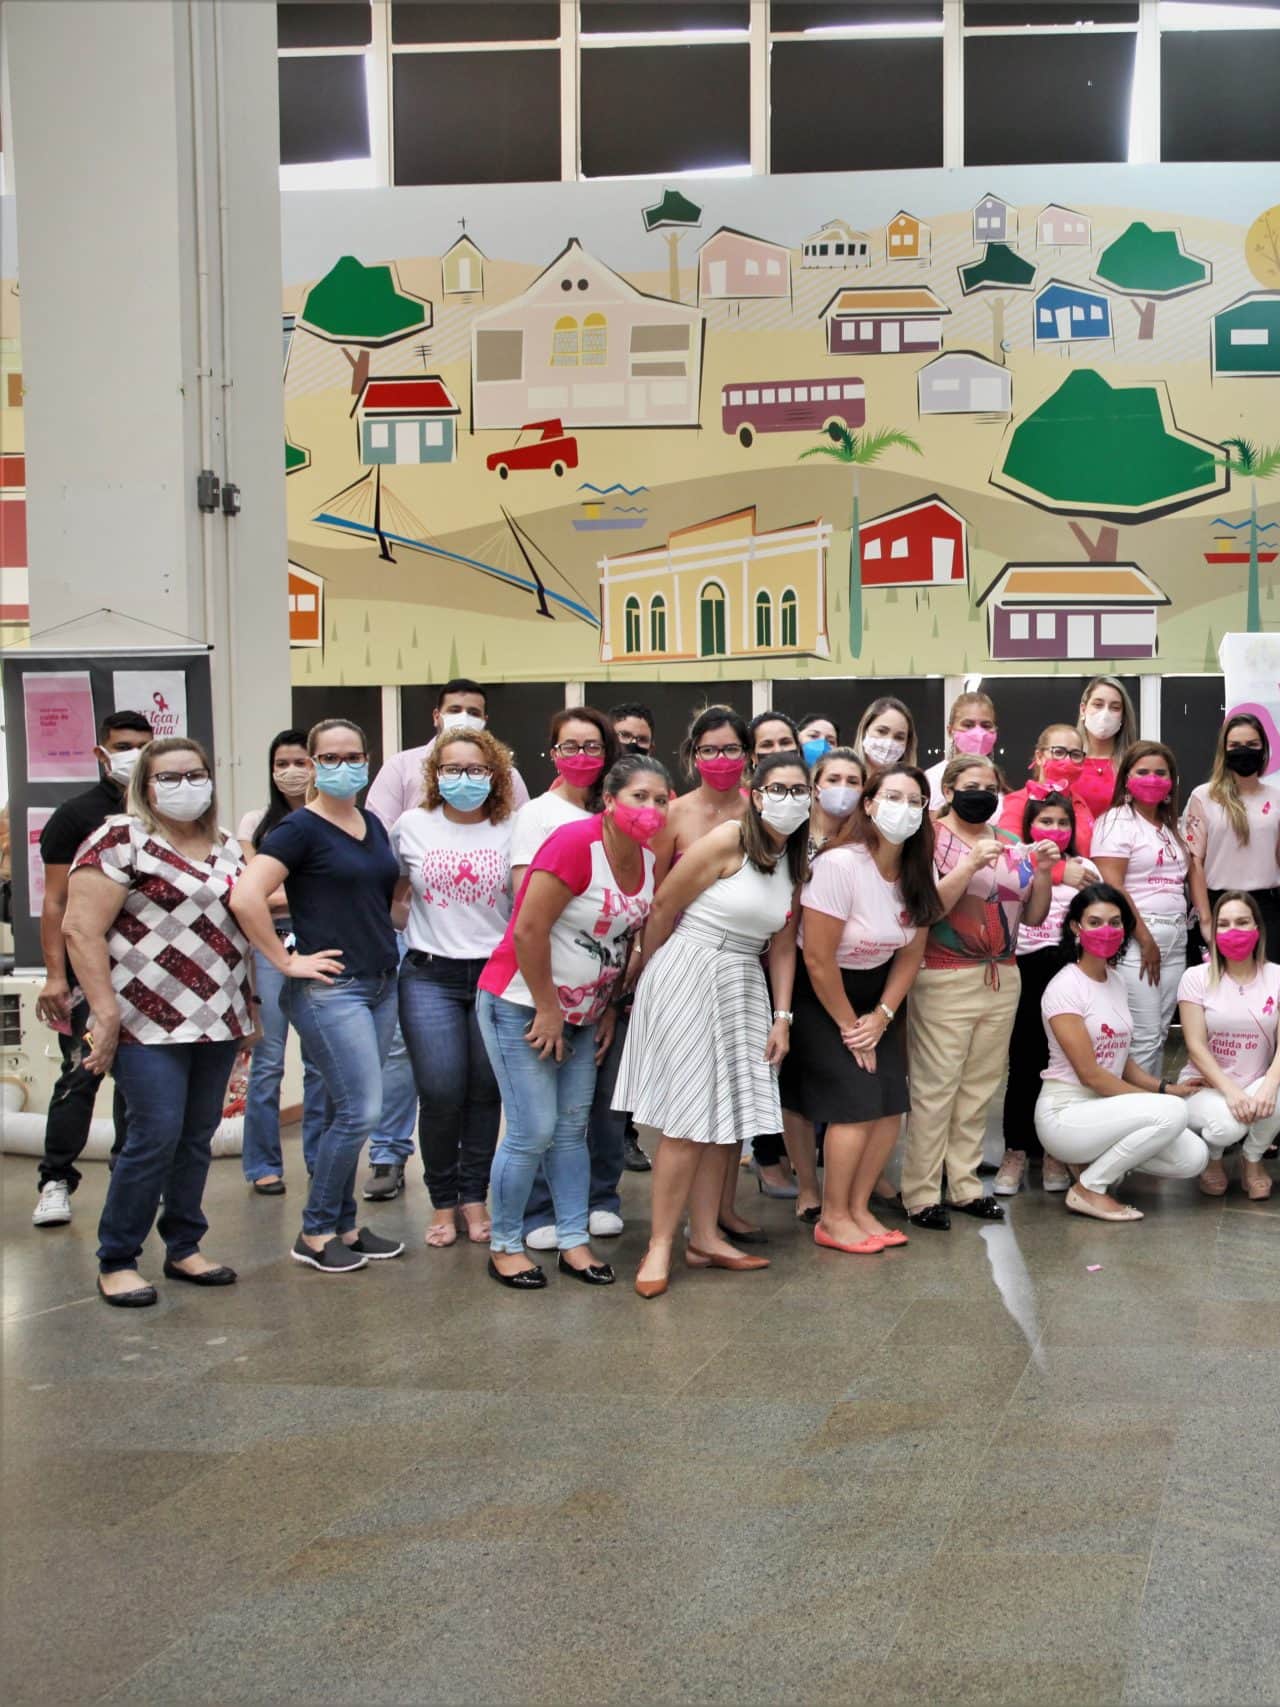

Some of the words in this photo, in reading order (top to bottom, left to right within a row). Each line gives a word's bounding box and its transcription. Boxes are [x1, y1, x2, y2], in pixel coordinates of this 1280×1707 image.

[1212, 1039, 1242, 1049] cuida
[1245, 1041, 1258, 1050] de
[1212, 1045, 1237, 1057] tudo
